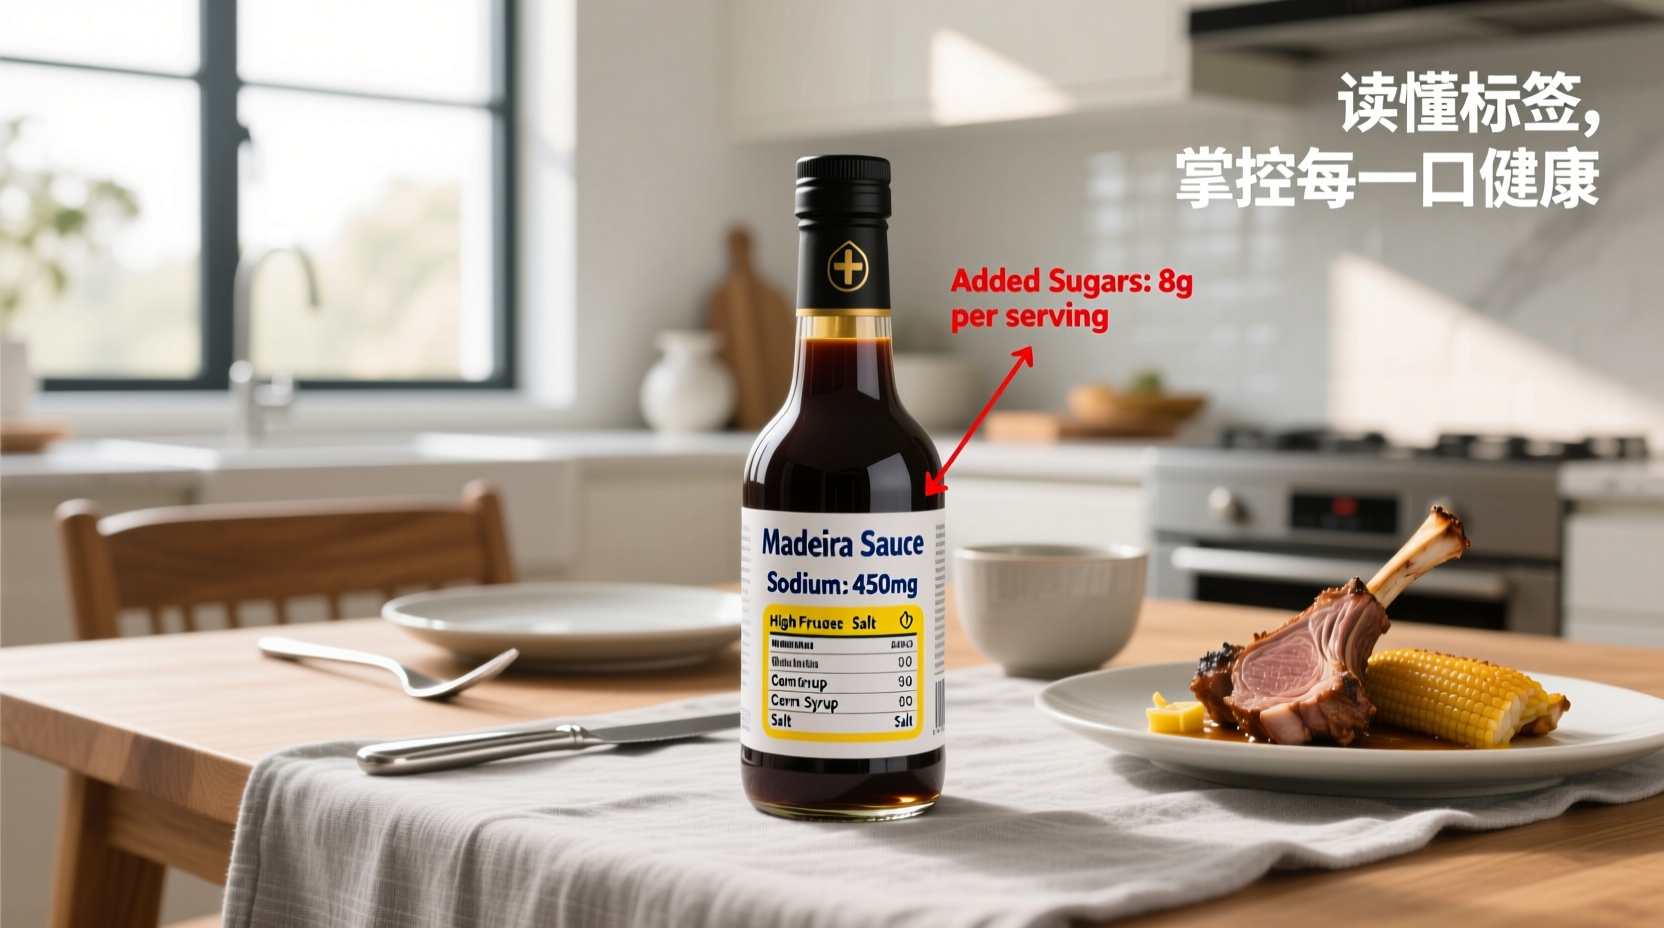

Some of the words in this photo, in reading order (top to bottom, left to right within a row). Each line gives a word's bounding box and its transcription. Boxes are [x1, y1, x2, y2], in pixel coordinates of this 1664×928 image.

[762, 528, 853, 557] Madeira
[860, 530, 924, 556] Sauce
[767, 571, 848, 595] Sodium:
[852, 573, 918, 598] 450mg
[770, 614, 796, 631] High
[852, 615, 876, 630] Salt
[804, 696, 839, 714] Syrup
[771, 713, 792, 728] Salt
[894, 713, 913, 728] Salt
